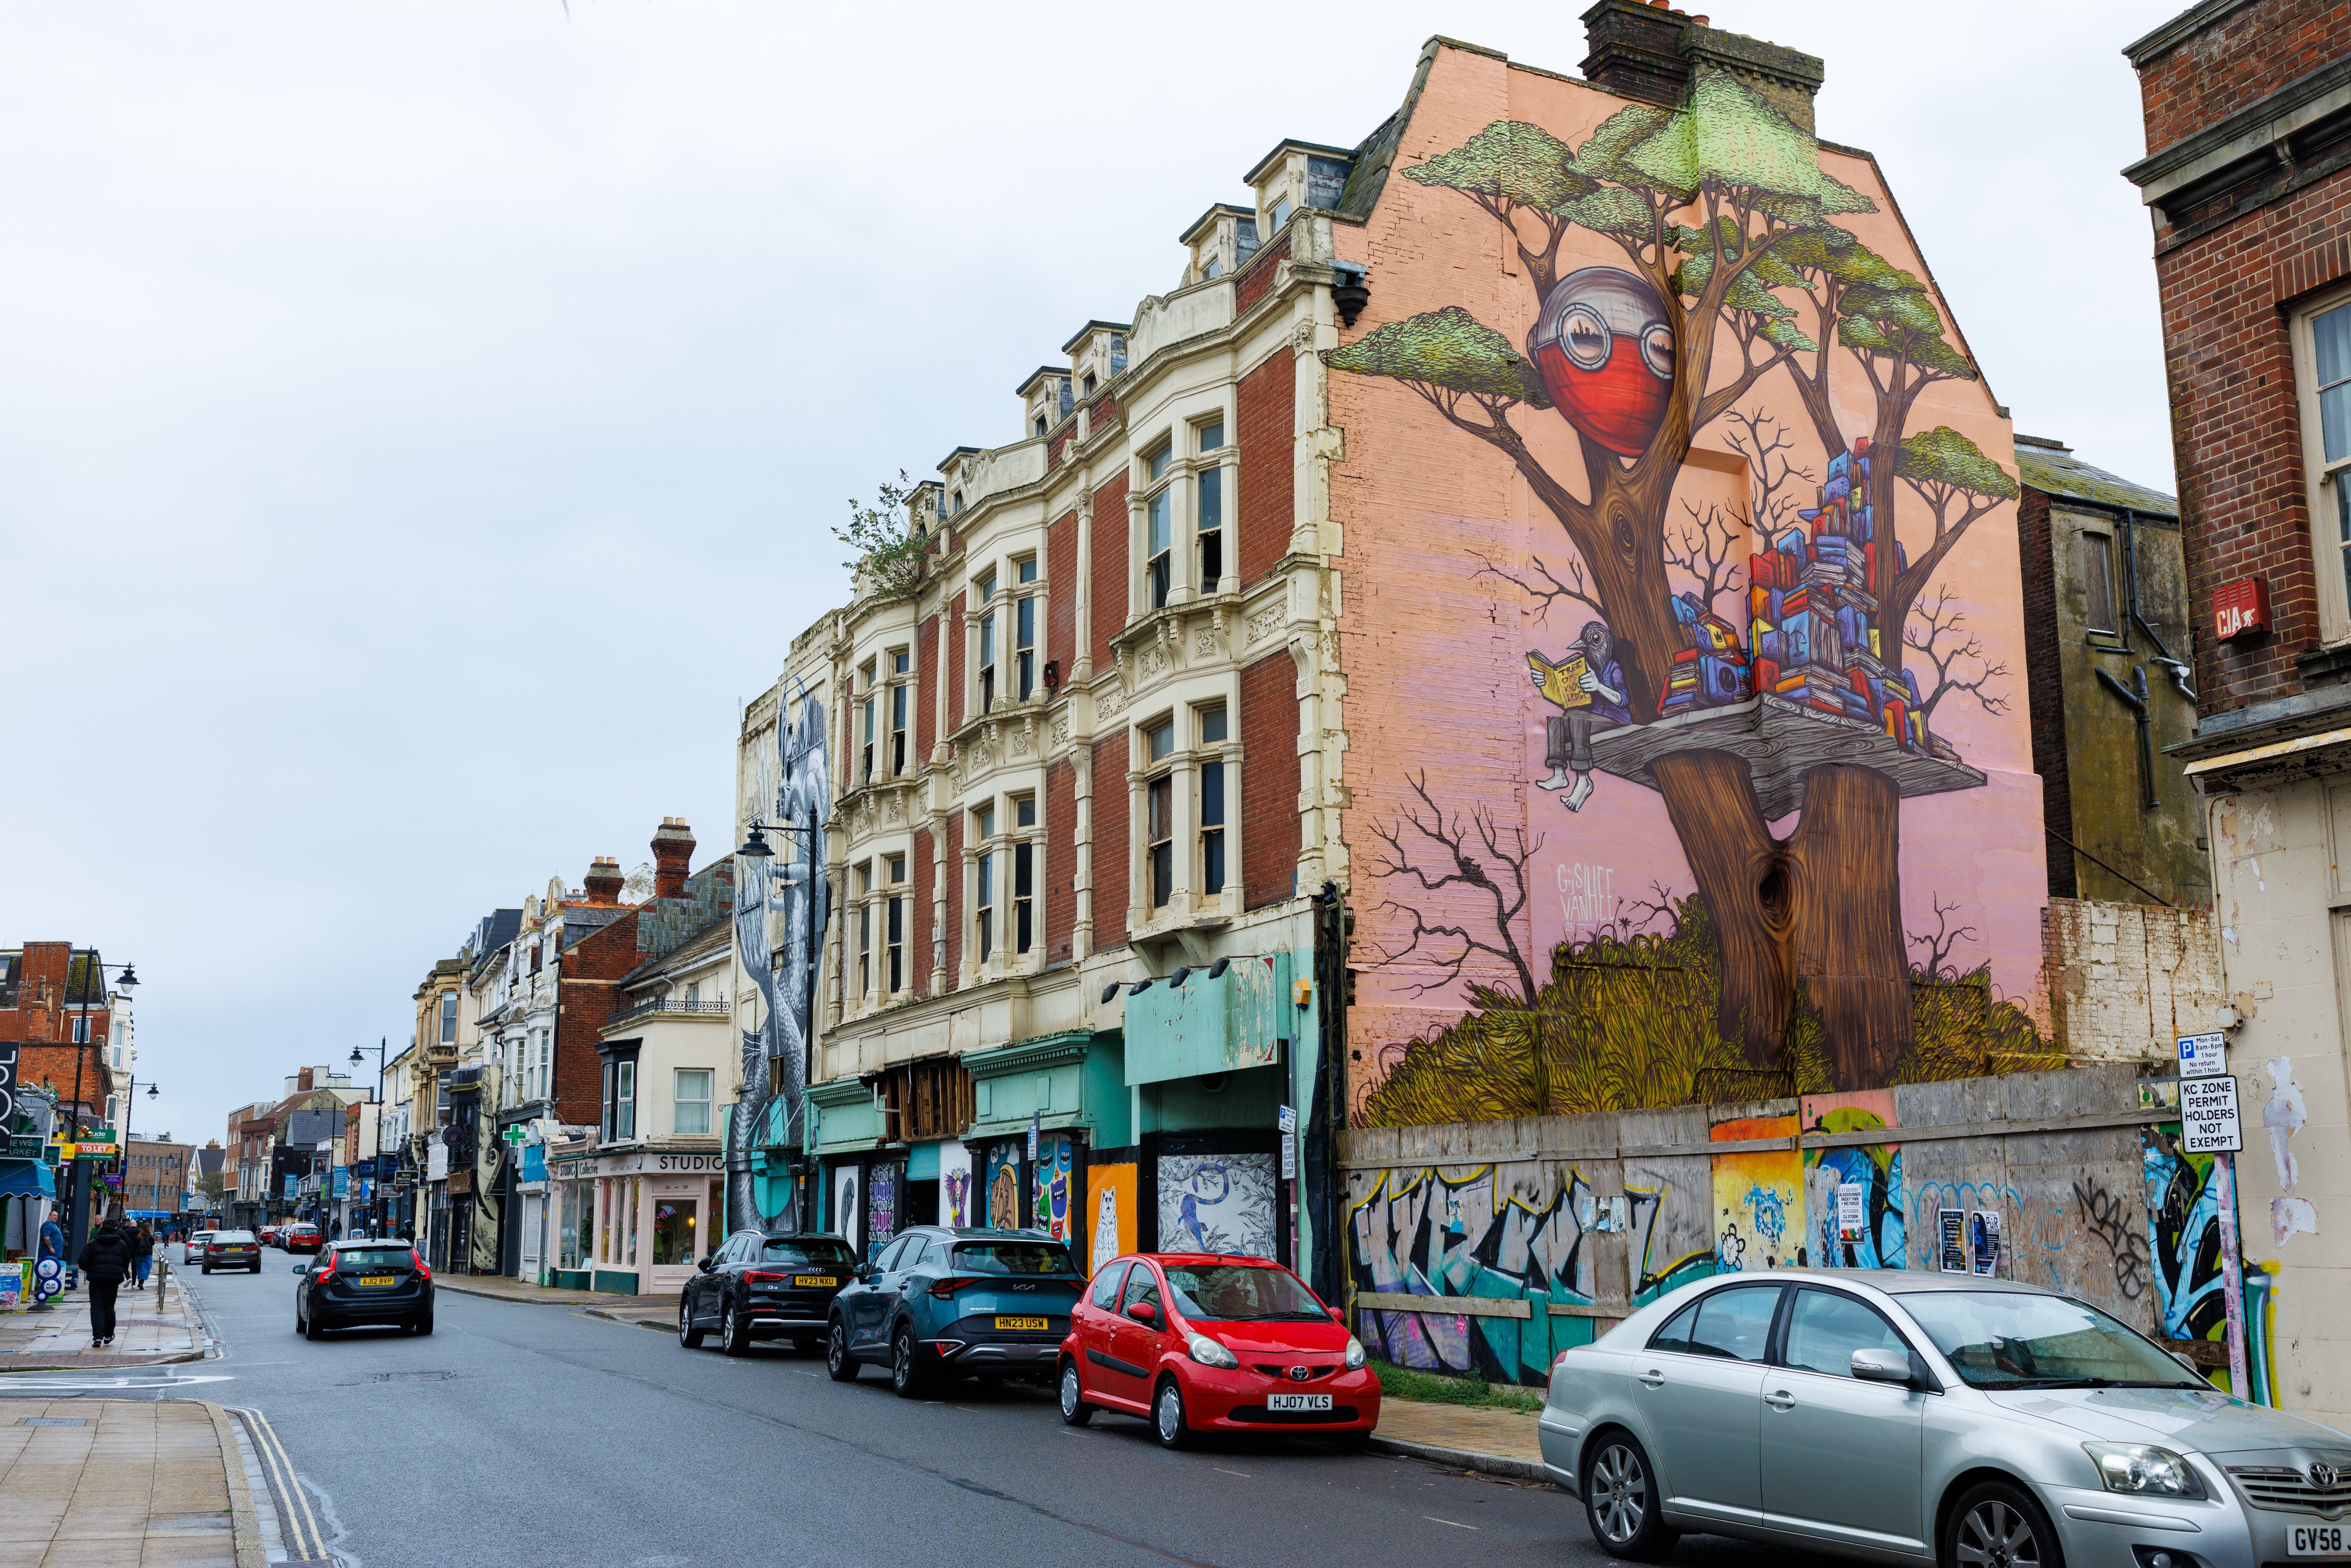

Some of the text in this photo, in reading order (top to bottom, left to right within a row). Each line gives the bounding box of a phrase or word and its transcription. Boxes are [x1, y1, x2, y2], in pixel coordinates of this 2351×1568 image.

[2216, 607, 2242, 636] CIA
[1558, 660, 1582, 675] TREE
[1562, 674, 1578, 684] OF
[1566, 922, 1575, 931] 25
[2182, 1043, 2192, 1057] P
[2183, 1081, 2232, 1095] KC ZONE
[2189, 1095, 2228, 1108] PERMIT
[1282, 1109, 1285, 1117] P
[2185, 1108, 2235, 1121] HOLDERS
[2199, 1123, 2222, 1134] NOT
[2190, 1135, 2233, 1148] EXEMPT
[580, 1162, 598, 1175] Collective
[659, 1155, 724, 1170] STUDIO
[878, 1170, 889, 1181] KIND
[873, 1181, 893, 1202] WORDS
[878, 1200, 888, 1211] KIND
[873, 1211, 891, 1231] HANDS
[877, 1231, 888, 1242] KIND
[999, 1318, 1043, 1328] HN23 USW
[1274, 1396, 1328, 1408] HJ07 VLS
[2295, 1528, 2341, 1550] GV58
